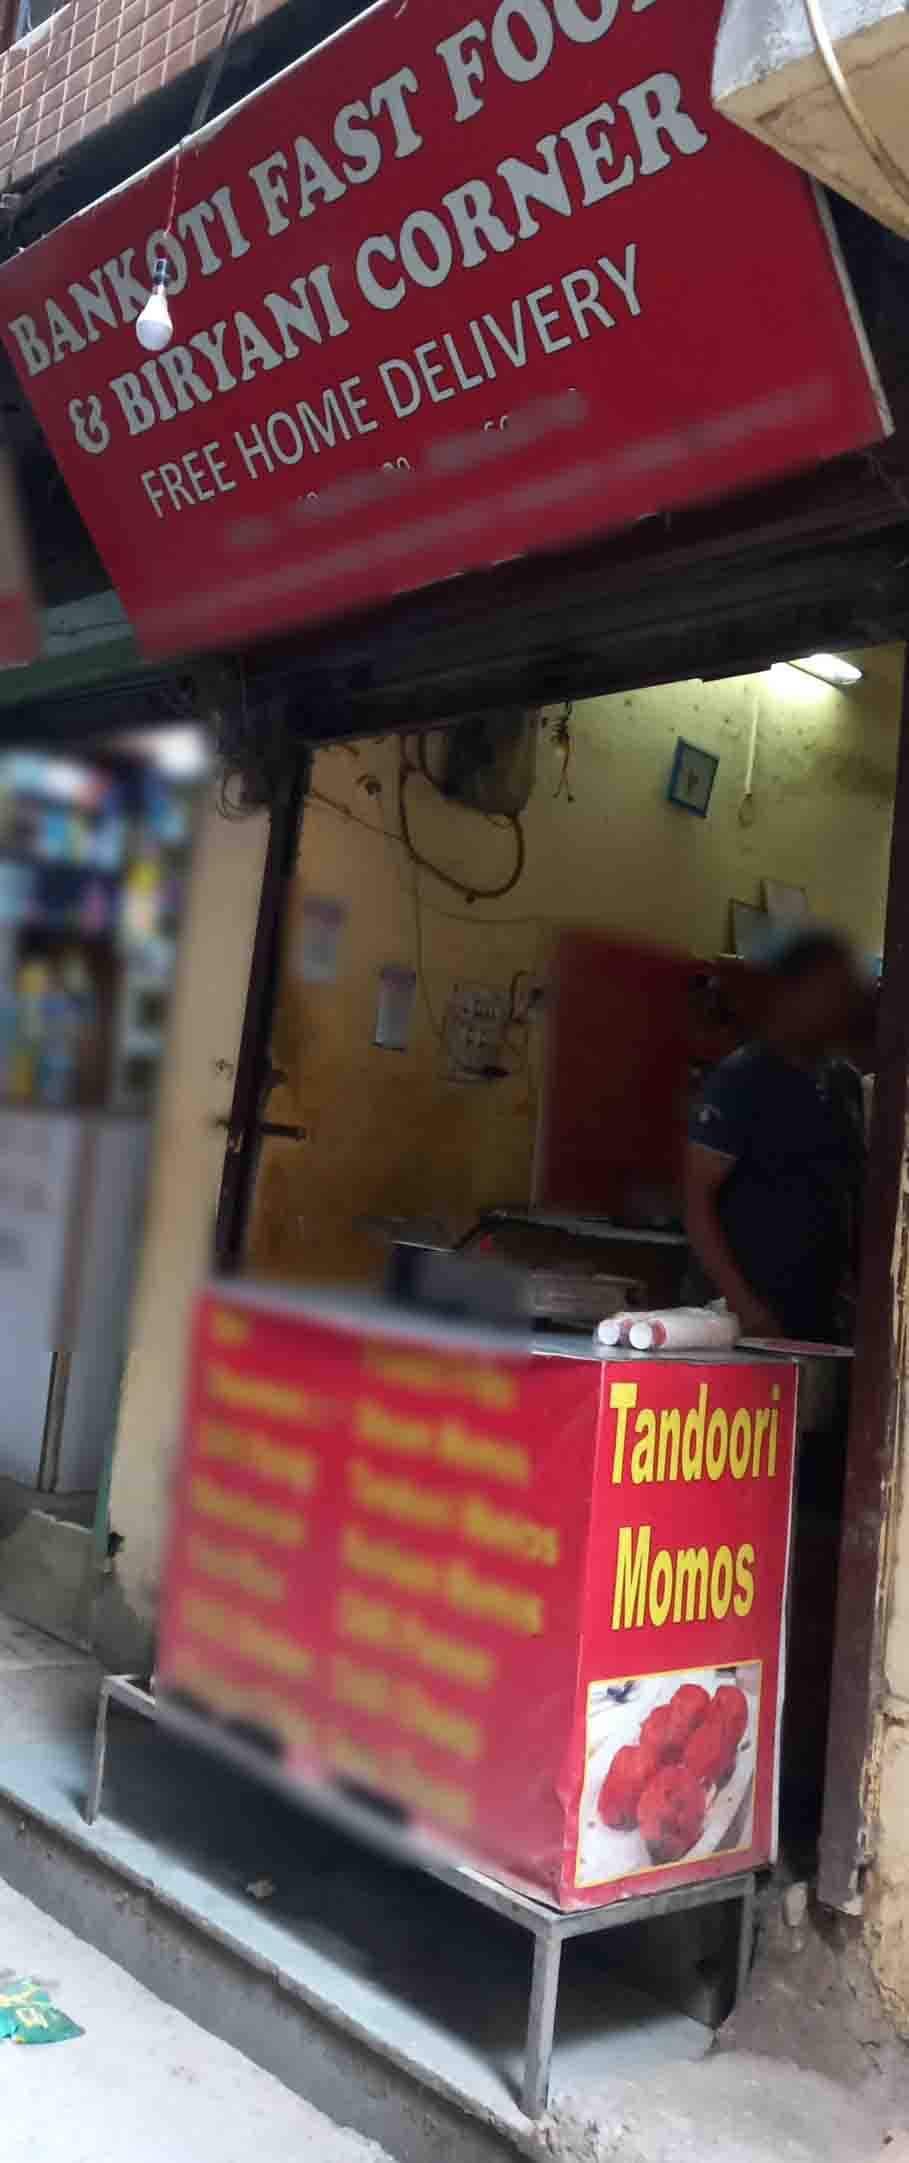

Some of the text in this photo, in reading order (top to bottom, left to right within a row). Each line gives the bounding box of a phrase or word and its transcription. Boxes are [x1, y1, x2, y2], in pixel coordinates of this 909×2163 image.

[7, 0, 656, 377] BANKOTI FAST FO
[68, 71, 709, 455] & BIRYANI CORNER
[142, 442, 236, 517] FREE
[234, 376, 377, 480] HOME
[377, 243, 645, 419] DELIVERY
[609, 1382, 780, 1484] Tandoori
[612, 1526, 756, 1631] Momos
